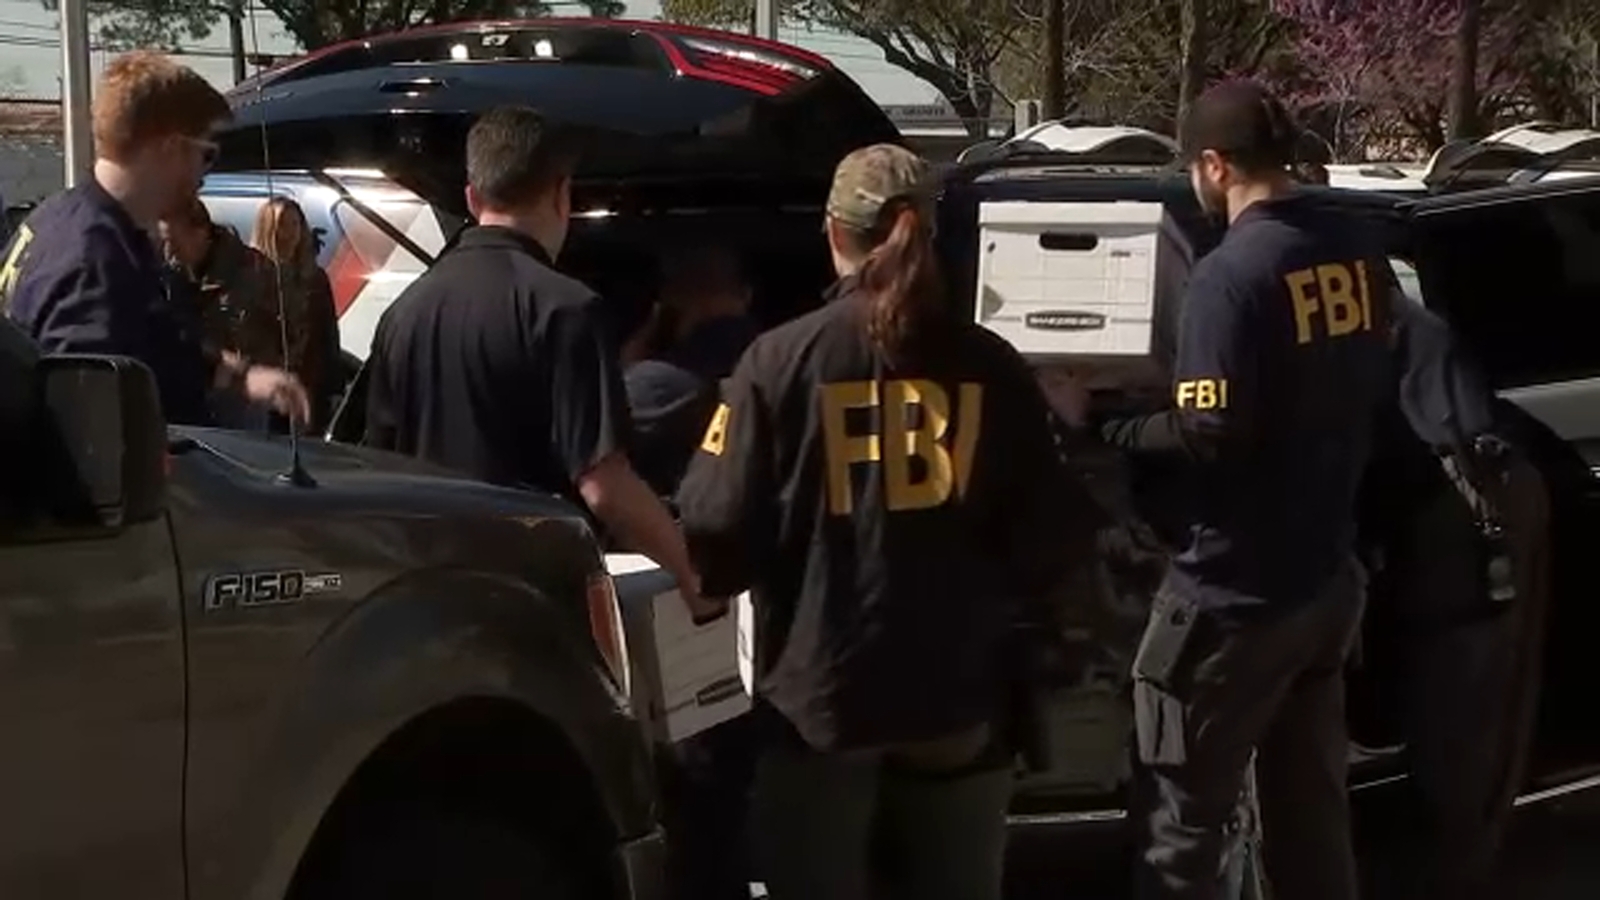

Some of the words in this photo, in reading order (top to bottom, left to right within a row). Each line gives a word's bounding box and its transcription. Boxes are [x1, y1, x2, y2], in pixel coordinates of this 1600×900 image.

[1284, 259, 1371, 344] FBI
[1177, 379, 1227, 409] FBI
[818, 379, 983, 515] FBI
